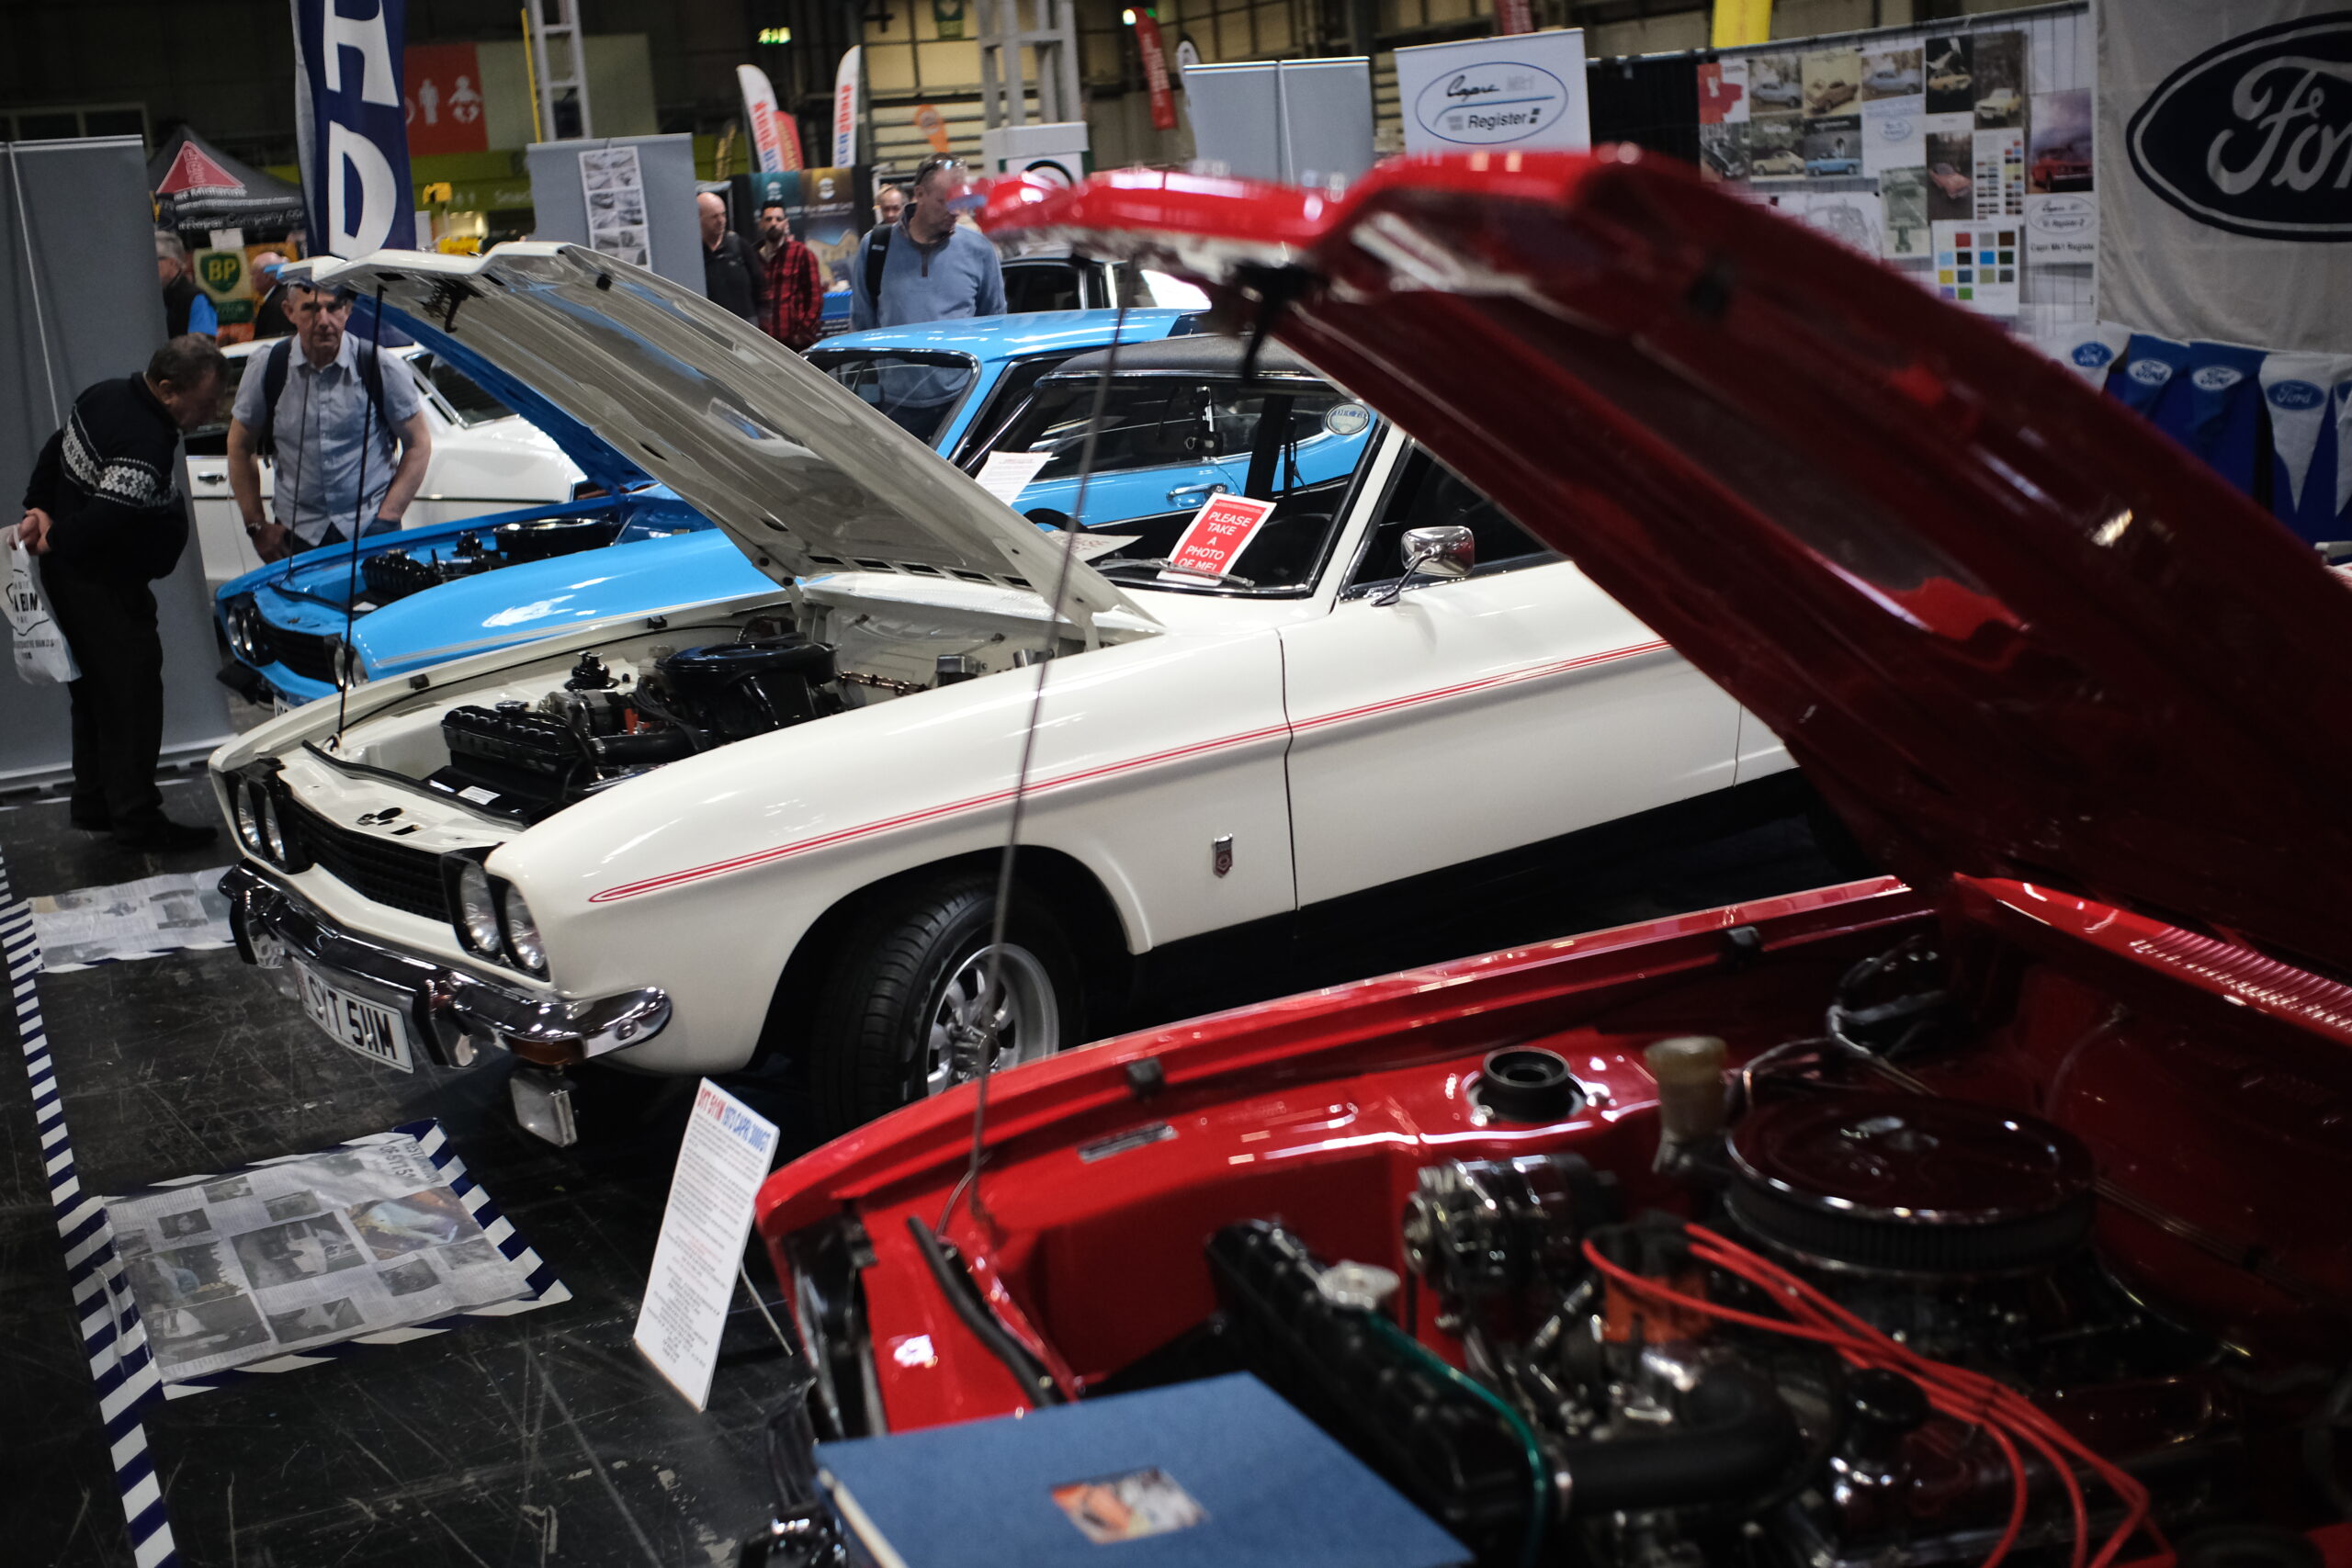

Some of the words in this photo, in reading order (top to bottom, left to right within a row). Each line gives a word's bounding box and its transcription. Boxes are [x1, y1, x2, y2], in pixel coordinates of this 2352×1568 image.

[1467, 111, 1528, 130] Register
[2207, 56, 2352, 195] For
[208, 258, 237, 282] BP
[2276, 384, 2314, 405] Ford
[1208, 512, 1252, 527] PLEASE
[1207, 523, 1238, 536] TAKE
[1206, 536, 1217, 546] A
[1184, 545, 1225, 560] PHOTO
[1178, 558, 1195, 567] OF
